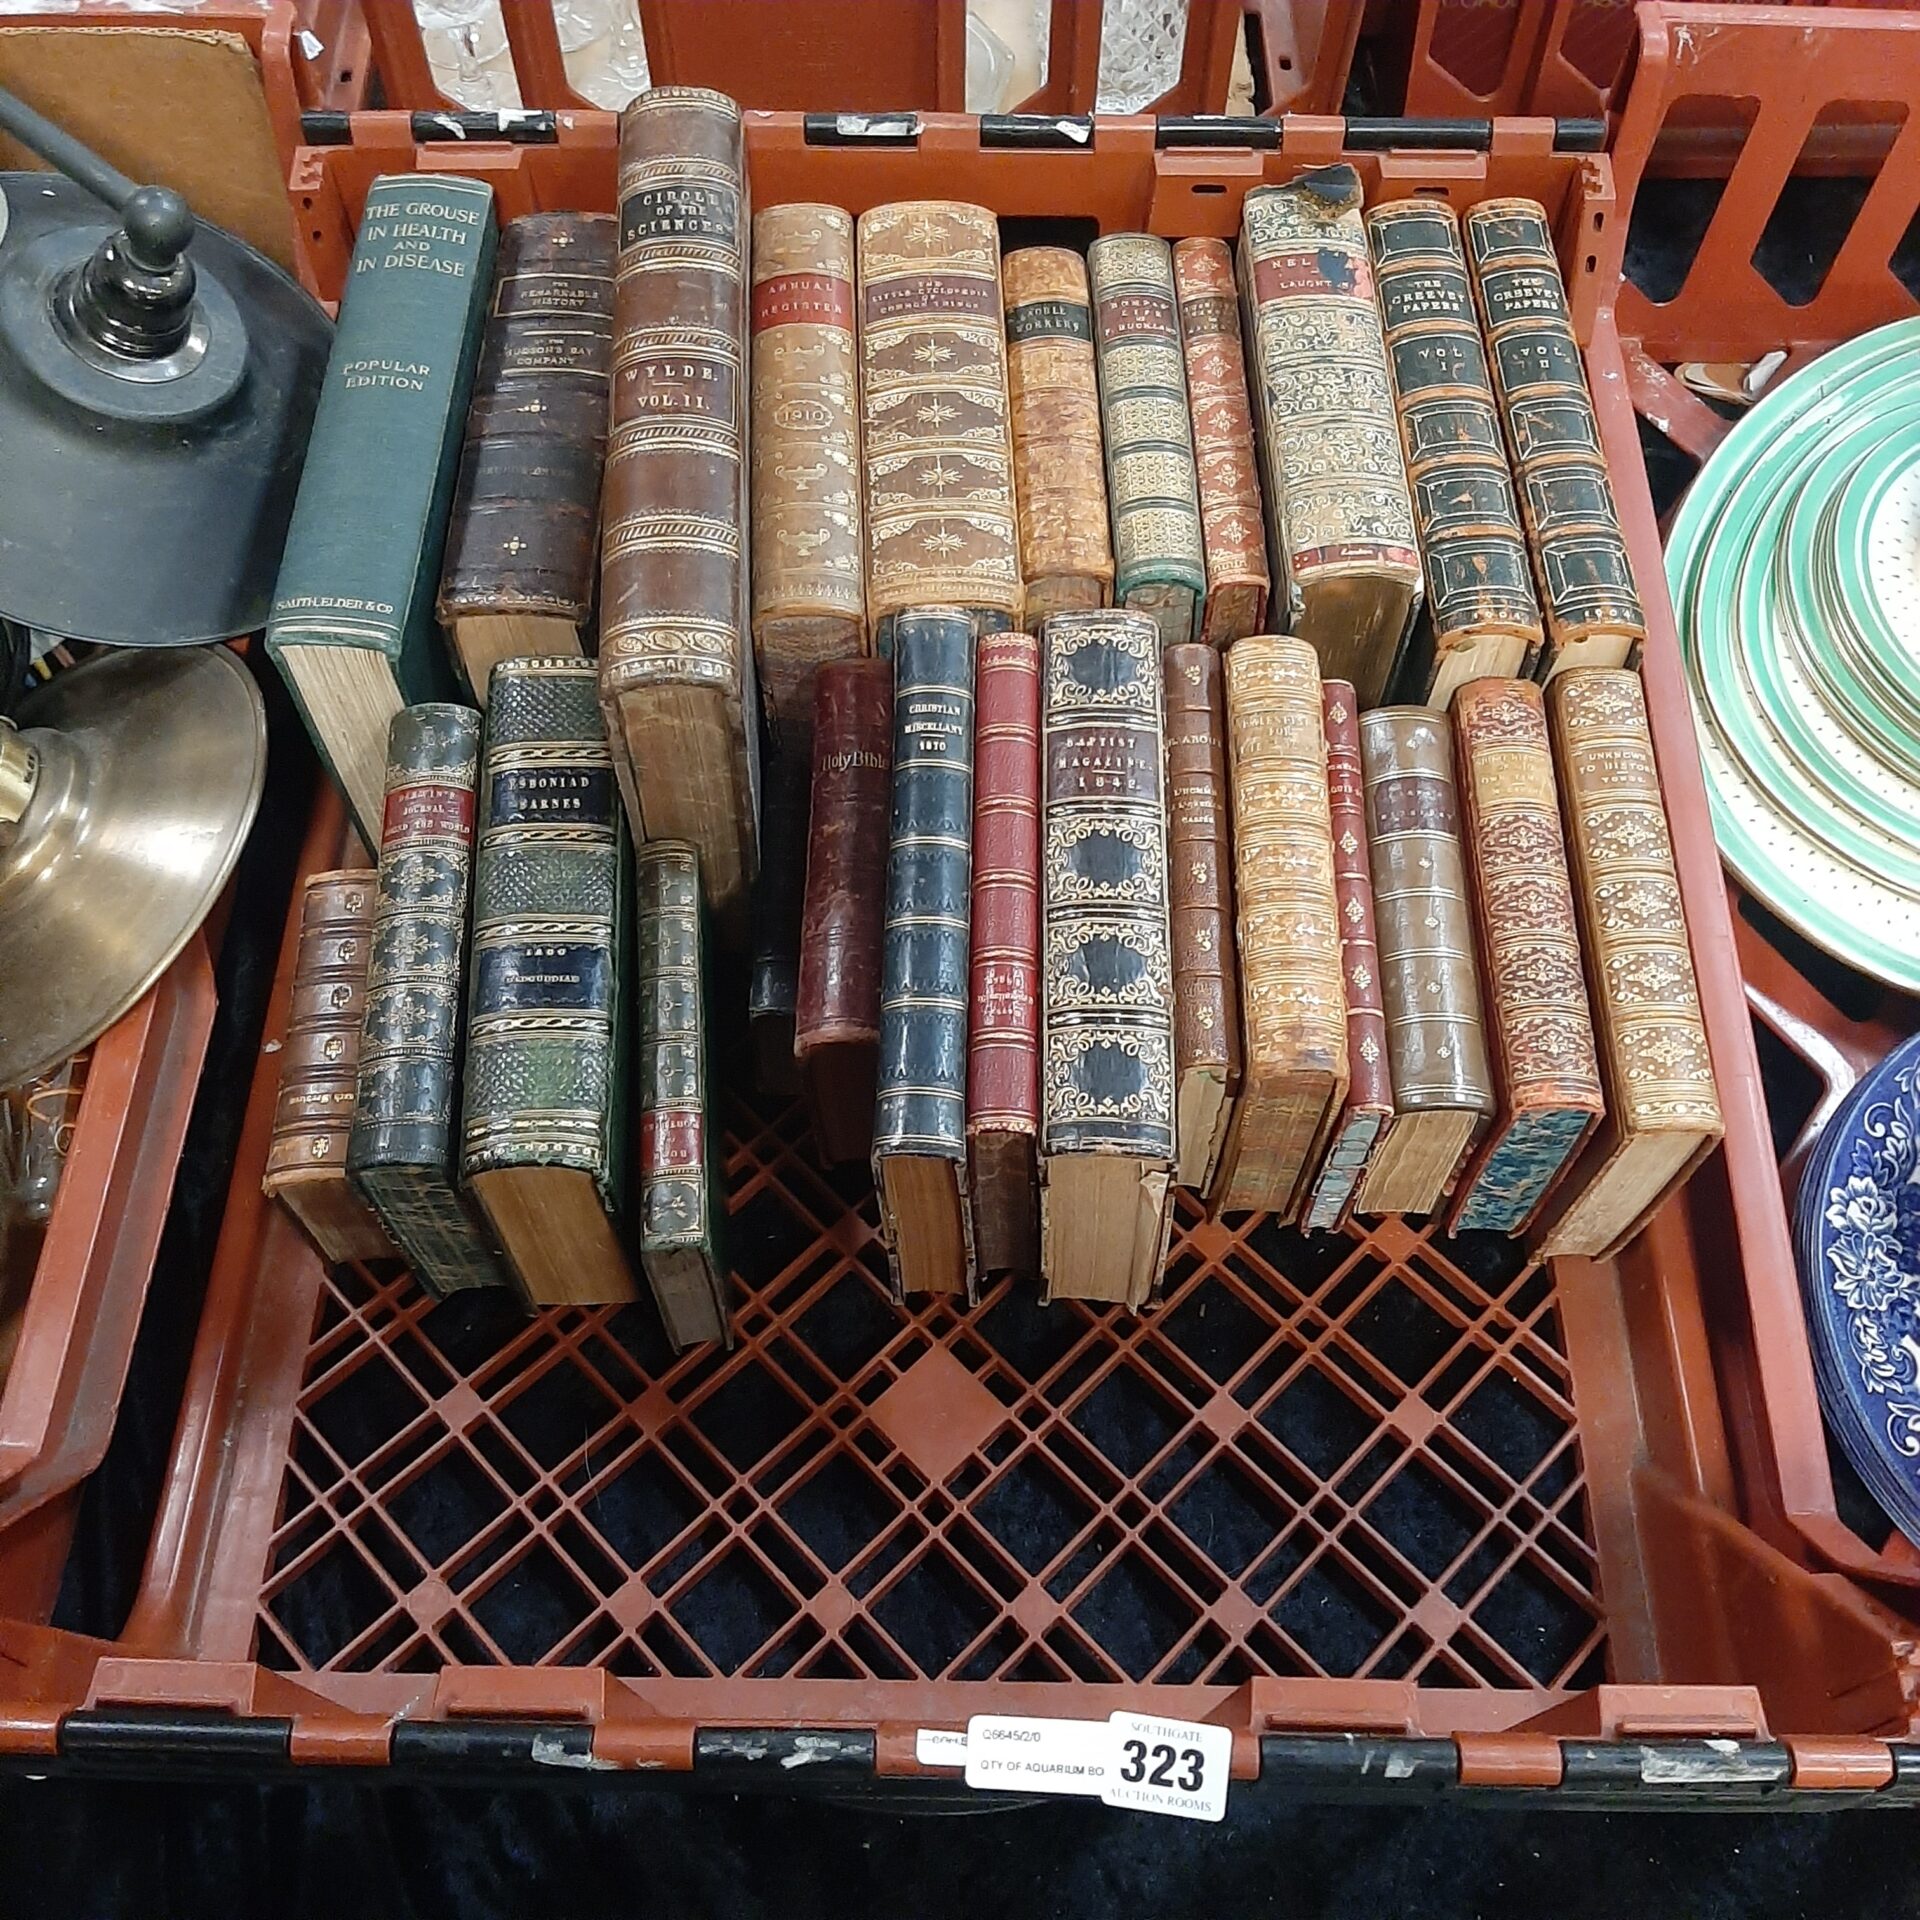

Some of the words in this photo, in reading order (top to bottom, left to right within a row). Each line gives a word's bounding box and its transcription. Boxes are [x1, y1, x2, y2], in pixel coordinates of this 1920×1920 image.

[366, 203, 400, 220] THE
[405, 202, 480, 225] GROUSE
[367, 225, 387, 241] IN
[392, 223, 467, 245] HEALTH
[627, 219, 725, 240] SCIENCES
[393, 240, 431, 251] AND
[356, 257, 377, 273] IN
[384, 253, 466, 277] DISEASE
[1402, 301, 1460, 314] PAPERS
[1504, 299, 1559, 312] PAPERS
[342, 359, 431, 375] POPULAR
[344, 375, 424, 391] EDITION
[909, 703, 961, 716] CHRISTIAN
[1588, 751, 1647, 761] UNKNOWN
[1579, 764, 1596, 774] TO
[1604, 762, 1656, 775] HISTORY
[1006, 1761, 1023, 1772] OF
[1119, 1739, 1205, 1792] 323
